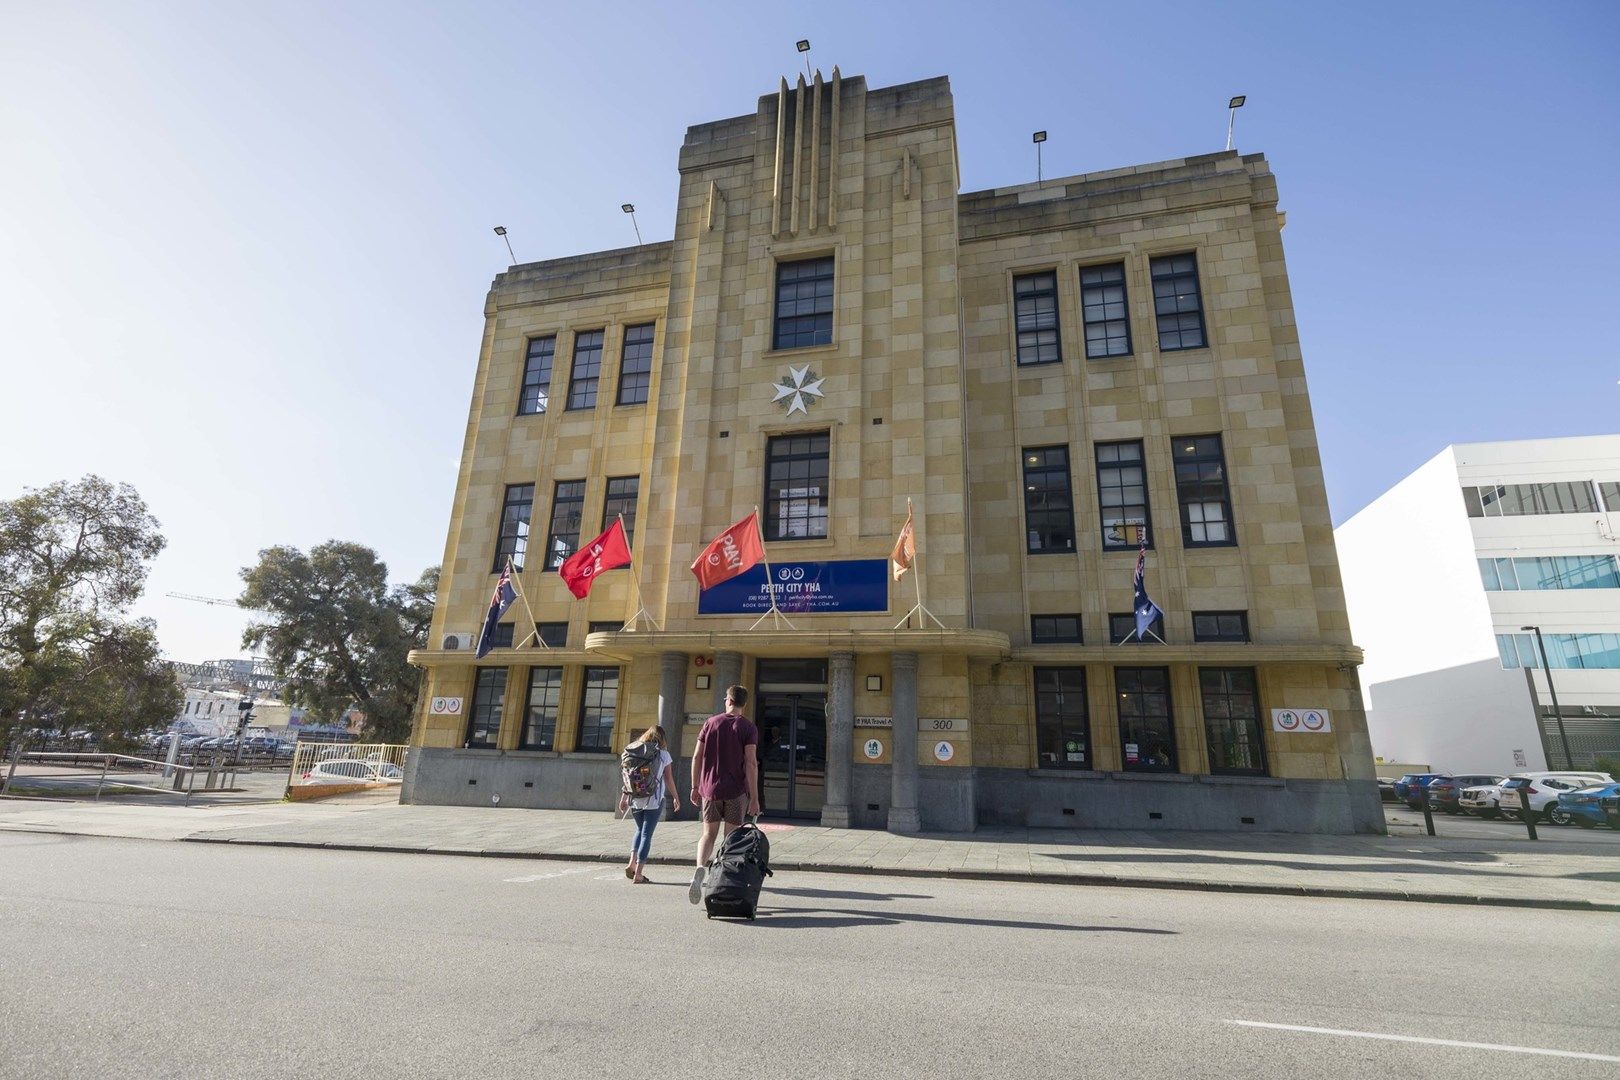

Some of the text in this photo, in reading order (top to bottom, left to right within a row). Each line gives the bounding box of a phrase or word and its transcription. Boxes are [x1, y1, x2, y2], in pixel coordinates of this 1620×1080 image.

[719, 533, 744, 571] PLAY
[786, 583, 803, 593] CITY
[805, 582, 821, 592] YHA
[932, 720, 953, 730] 300
